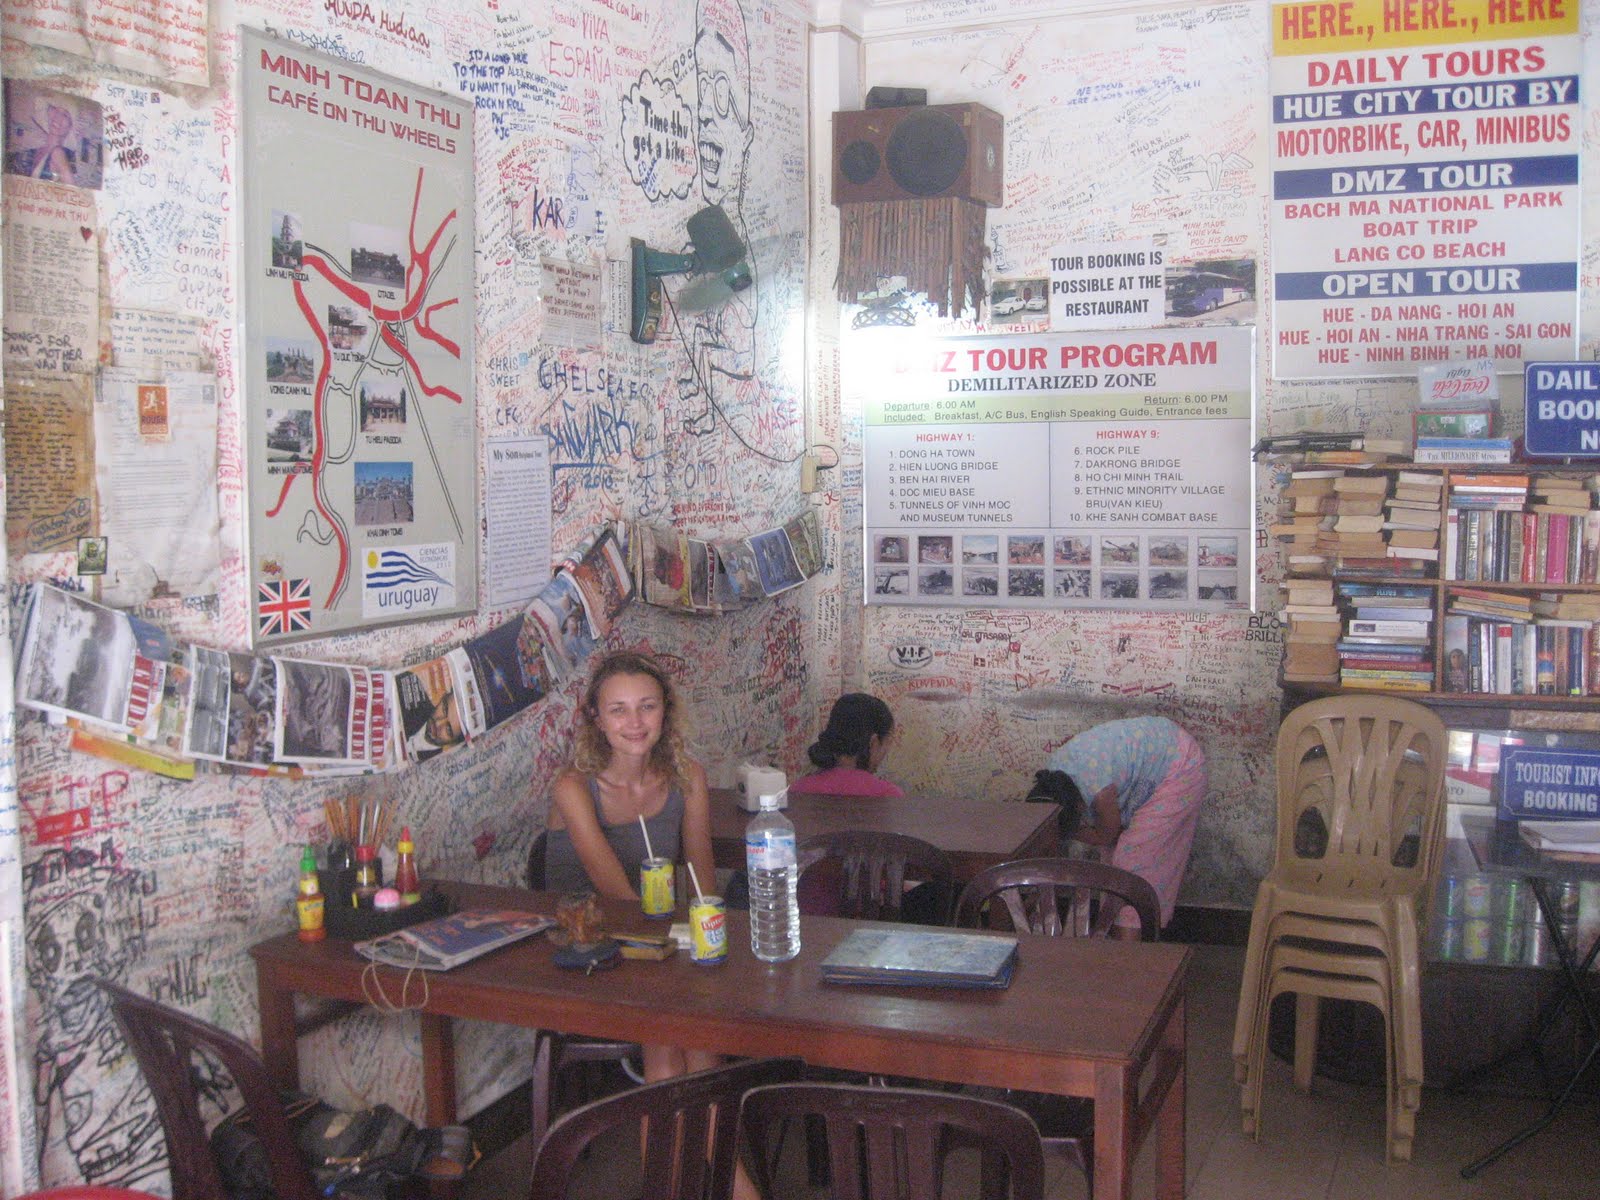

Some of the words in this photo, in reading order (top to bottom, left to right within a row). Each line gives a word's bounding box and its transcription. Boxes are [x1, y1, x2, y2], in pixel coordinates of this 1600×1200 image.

[1282, 4, 1374, 41] HERE.,
[1383, 0, 1478, 33] HERE.,
[1488, 0, 1565, 25] HERE
[453, 62, 467, 77] TO
[469, 63, 487, 78] THE
[489, 65, 504, 78] TOP
[549, 41, 612, 86] ESPAÑA
[1308, 55, 1409, 87] DAILY
[1423, 46, 1546, 78] TOURS
[261, 49, 330, 89] MINH
[337, 73, 409, 114] TOAN
[415, 99, 461, 130] THU
[1283, 95, 1342, 119] HUE
[1354, 90, 1422, 114] CITY
[1432, 85, 1516, 109] TOUR
[1529, 80, 1572, 103] BY
[560, 95, 579, 113] 2010
[268, 85, 319, 115] CAFÉ
[324, 102, 347, 123] ON
[352, 111, 386, 135] THU
[390, 120, 456, 154] WHEELS
[640, 96, 668, 134] Time
[672, 110, 688, 139] thu
[1277, 122, 1410, 157] MOTORBIKE,
[1417, 119, 1467, 151] CAR,
[1476, 114, 1570, 145] MINIBUS
[633, 133, 653, 161] get
[656, 142, 662, 158] a
[1332, 169, 1405, 194] DMZ
[1418, 164, 1513, 189] TOUR
[1285, 202, 1340, 219] BACH
[1349, 200, 1380, 216] MA
[1388, 195, 1493, 214] NATIONAL
[1504, 192, 1563, 208] PARK
[1363, 221, 1419, 238] BOAT
[1428, 219, 1478, 235] TRIP
[1051, 256, 1083, 271] TOUR
[1088, 253, 1145, 269] BOOKING
[1149, 251, 1163, 265] IS
[1334, 247, 1388, 263] LANG
[1396, 245, 1425, 260] CO
[1433, 242, 1506, 258] BEACH
[1052, 278, 1114, 294] POSSIBLE
[1119, 277, 1134, 289] AT
[1138, 275, 1162, 289] THE
[1323, 272, 1414, 296] OPEN
[1426, 269, 1520, 292] TOUR
[1066, 299, 1149, 317] RESTAURANT
[1323, 308, 1354, 323] HUE
[1371, 307, 1392, 321] DA
[1398, 305, 1441, 321] NANG
[1458, 303, 1487, 319] HOI
[1493, 303, 1514, 317] AN
[1279, 330, 1309, 345] HUE
[1326, 329, 1353, 343] HOI
[1359, 328, 1380, 342] AN
[1396, 327, 1428, 341] NHA
[1434, 325, 1489, 340] TRANG
[1505, 324, 1532, 339] SAI
[1538, 323, 1571, 338] GON
[967, 347, 1047, 371] TOUR
[1061, 341, 1217, 368] PROGRAM
[1318, 349, 1349, 364] HUE
[1366, 346, 1404, 362] NINH
[1411, 346, 1449, 360] BINH
[1466, 344, 1487, 359] HA
[1494, 344, 1521, 359] NOI
[948, 374, 1098, 392] DEMILITARIZED
[1104, 373, 1156, 388] ZONE
[1537, 370, 1600, 390] DAIL
[1144, 396, 1181, 405] Return:
[1184, 395, 1207, 403] 6.00
[1211, 395, 1228, 403] PM
[1539, 400, 1600, 420] BOO
[884, 413, 926, 422] Included:
[935, 412, 982, 420] Breakfast,
[985, 411, 1003, 419] A/C
[1006, 411, 1027, 419] Bus,
[1031, 409, 1066, 420] English
[1070, 409, 1116, 418] Speaking
[1120, 408, 1152, 417] Guide,
[1156, 407, 1202, 416] Entrance
[1206, 407, 1227, 415] fees
[916, 434, 963, 442] HIGHWAY
[1097, 431, 1147, 439] HIGHWAY
[1074, 447, 1082, 455] 6.
[1118, 446, 1140, 454] PILE
[1441, 451, 1478, 460] MILLIONAIRE
[961, 462, 998, 470] BRIDGE
[1086, 460, 1137, 468] DAKRONG
[1140, 459, 1181, 467] BRIDGE
[1104, 473, 1121, 481] CHI
[1125, 473, 1150, 481] MINH
[1154, 473, 1183, 481] TRAIL
[949, 488, 975, 496] BASE
[1074, 487, 1082, 495] 9.
[1086, 487, 1124, 495] ETHNIC
[1127, 486, 1177, 494] MINORITY
[1181, 486, 1225, 494] VILLAGE
[947, 501, 959, 509] OF
[988, 501, 1011, 509] MOC
[1086, 500, 1132, 509] BRU(VAN
[1135, 500, 1162, 508] KIEU)
[1189, 513, 1217, 521] BASE
[378, 586, 438, 610] uruguay
[1516, 763, 1572, 785] TOURIST
[1524, 790, 1597, 812] BOOKING
